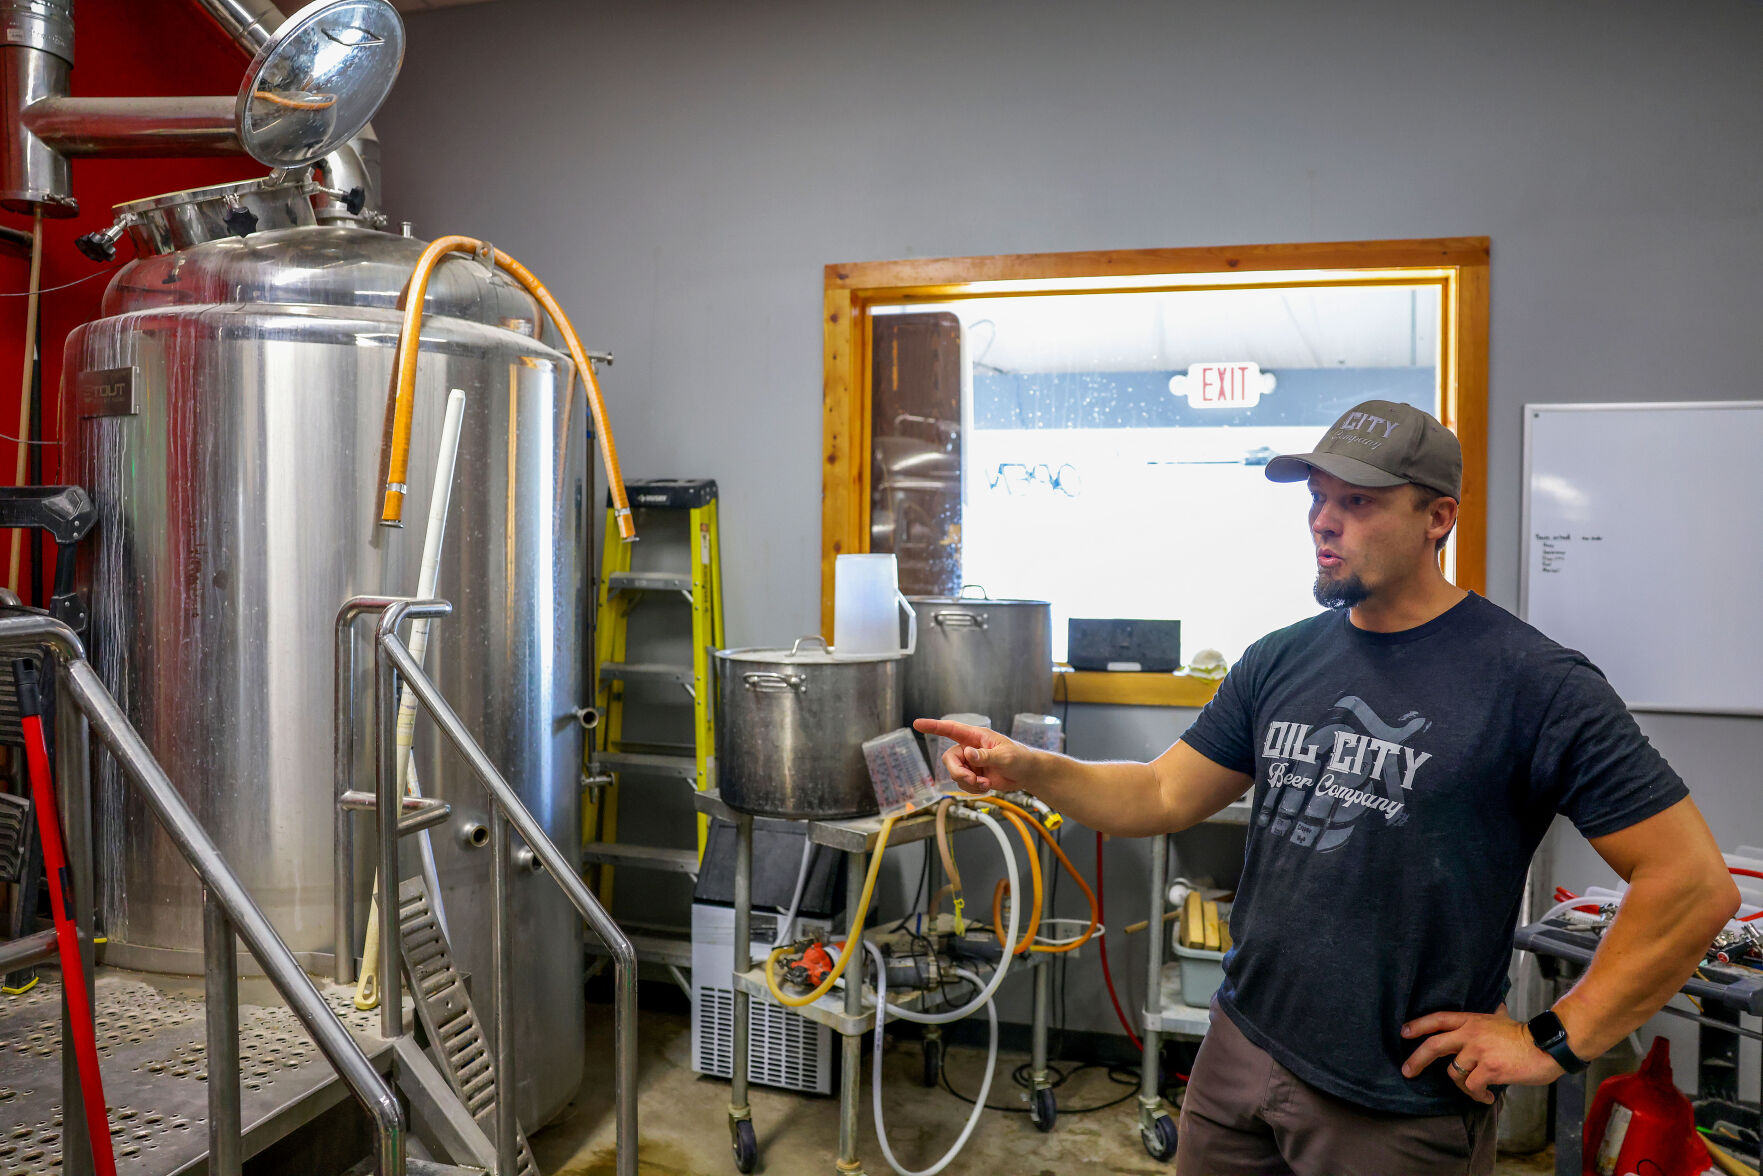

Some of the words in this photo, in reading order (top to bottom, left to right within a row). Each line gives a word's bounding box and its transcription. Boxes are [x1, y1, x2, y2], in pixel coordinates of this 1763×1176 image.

[1202, 366, 1249, 401] EXIT
[1341, 411, 1400, 438] CITY
[1261, 720, 1320, 764] OIL
[1327, 730, 1433, 790] CITY
[1267, 762, 1314, 788] Beer
[1314, 773, 1405, 820] Company
